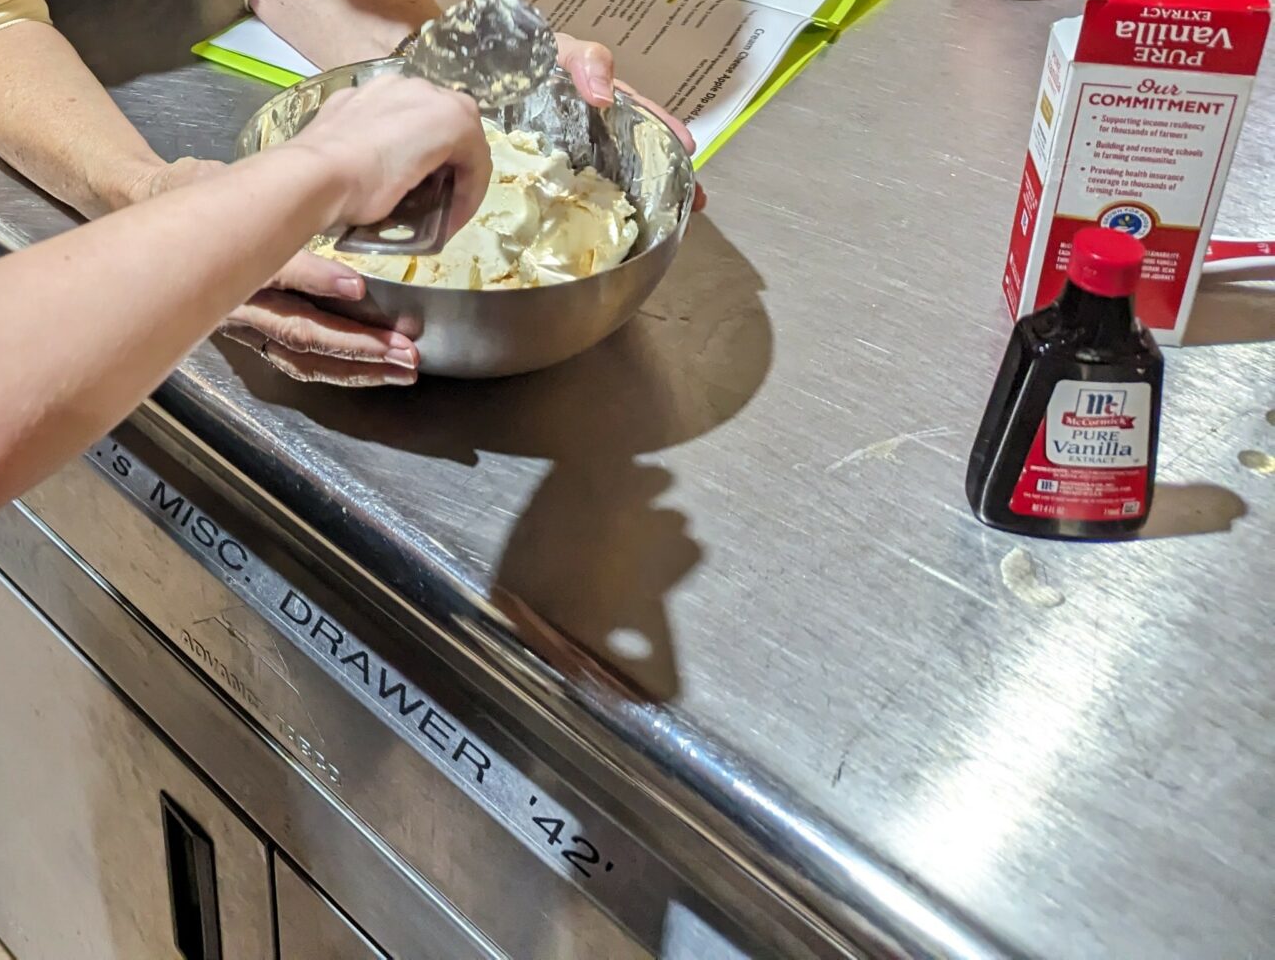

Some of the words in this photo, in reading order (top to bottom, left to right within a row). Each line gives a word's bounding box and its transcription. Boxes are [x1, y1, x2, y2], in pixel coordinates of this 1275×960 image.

[1140, 7, 1211, 21] EXTRACT
[744, 28, 765, 51] Cream
[1116, 21, 1233, 49] Vanilla
[725, 51, 748, 74] Cheese
[1133, 47, 1205, 66] PURE
[710, 74, 731, 92] Apple
[1137, 79, 1184, 96] Our
[701, 92, 716, 104] Dip
[1089, 93, 1224, 115] COMMITMENT
[691, 104, 705, 116] and
[1101, 115, 1141, 126] Supporting
[1143, 120, 1168, 128] income
[1111, 126, 1148, 136] thousands
[1150, 129, 1157, 137] of
[1159, 130, 1188, 139] farmers
[1096, 140, 1124, 151] Building
[1141, 146, 1174, 156] restoring
[1175, 149, 1203, 157] schools
[1102, 152, 1129, 161] farming
[1131, 154, 1176, 164] communities
[1090, 166, 1123, 177] Providing
[1125, 169, 1147, 178] health
[1149, 173, 1184, 181] insurance
[1088, 177, 1120, 186] coverage
[1130, 180, 1166, 189] thousands
[1086, 186, 1113, 196] farming
[1115, 188, 1142, 197] families
[1065, 416, 1126, 425] McCormick
[1072, 430, 1120, 441] PURE
[1053, 440, 1131, 456] Vanilla
[150, 480, 251, 583] MISC.
[279, 589, 492, 784] DRAWER
[528, 795, 614, 880] '42'
